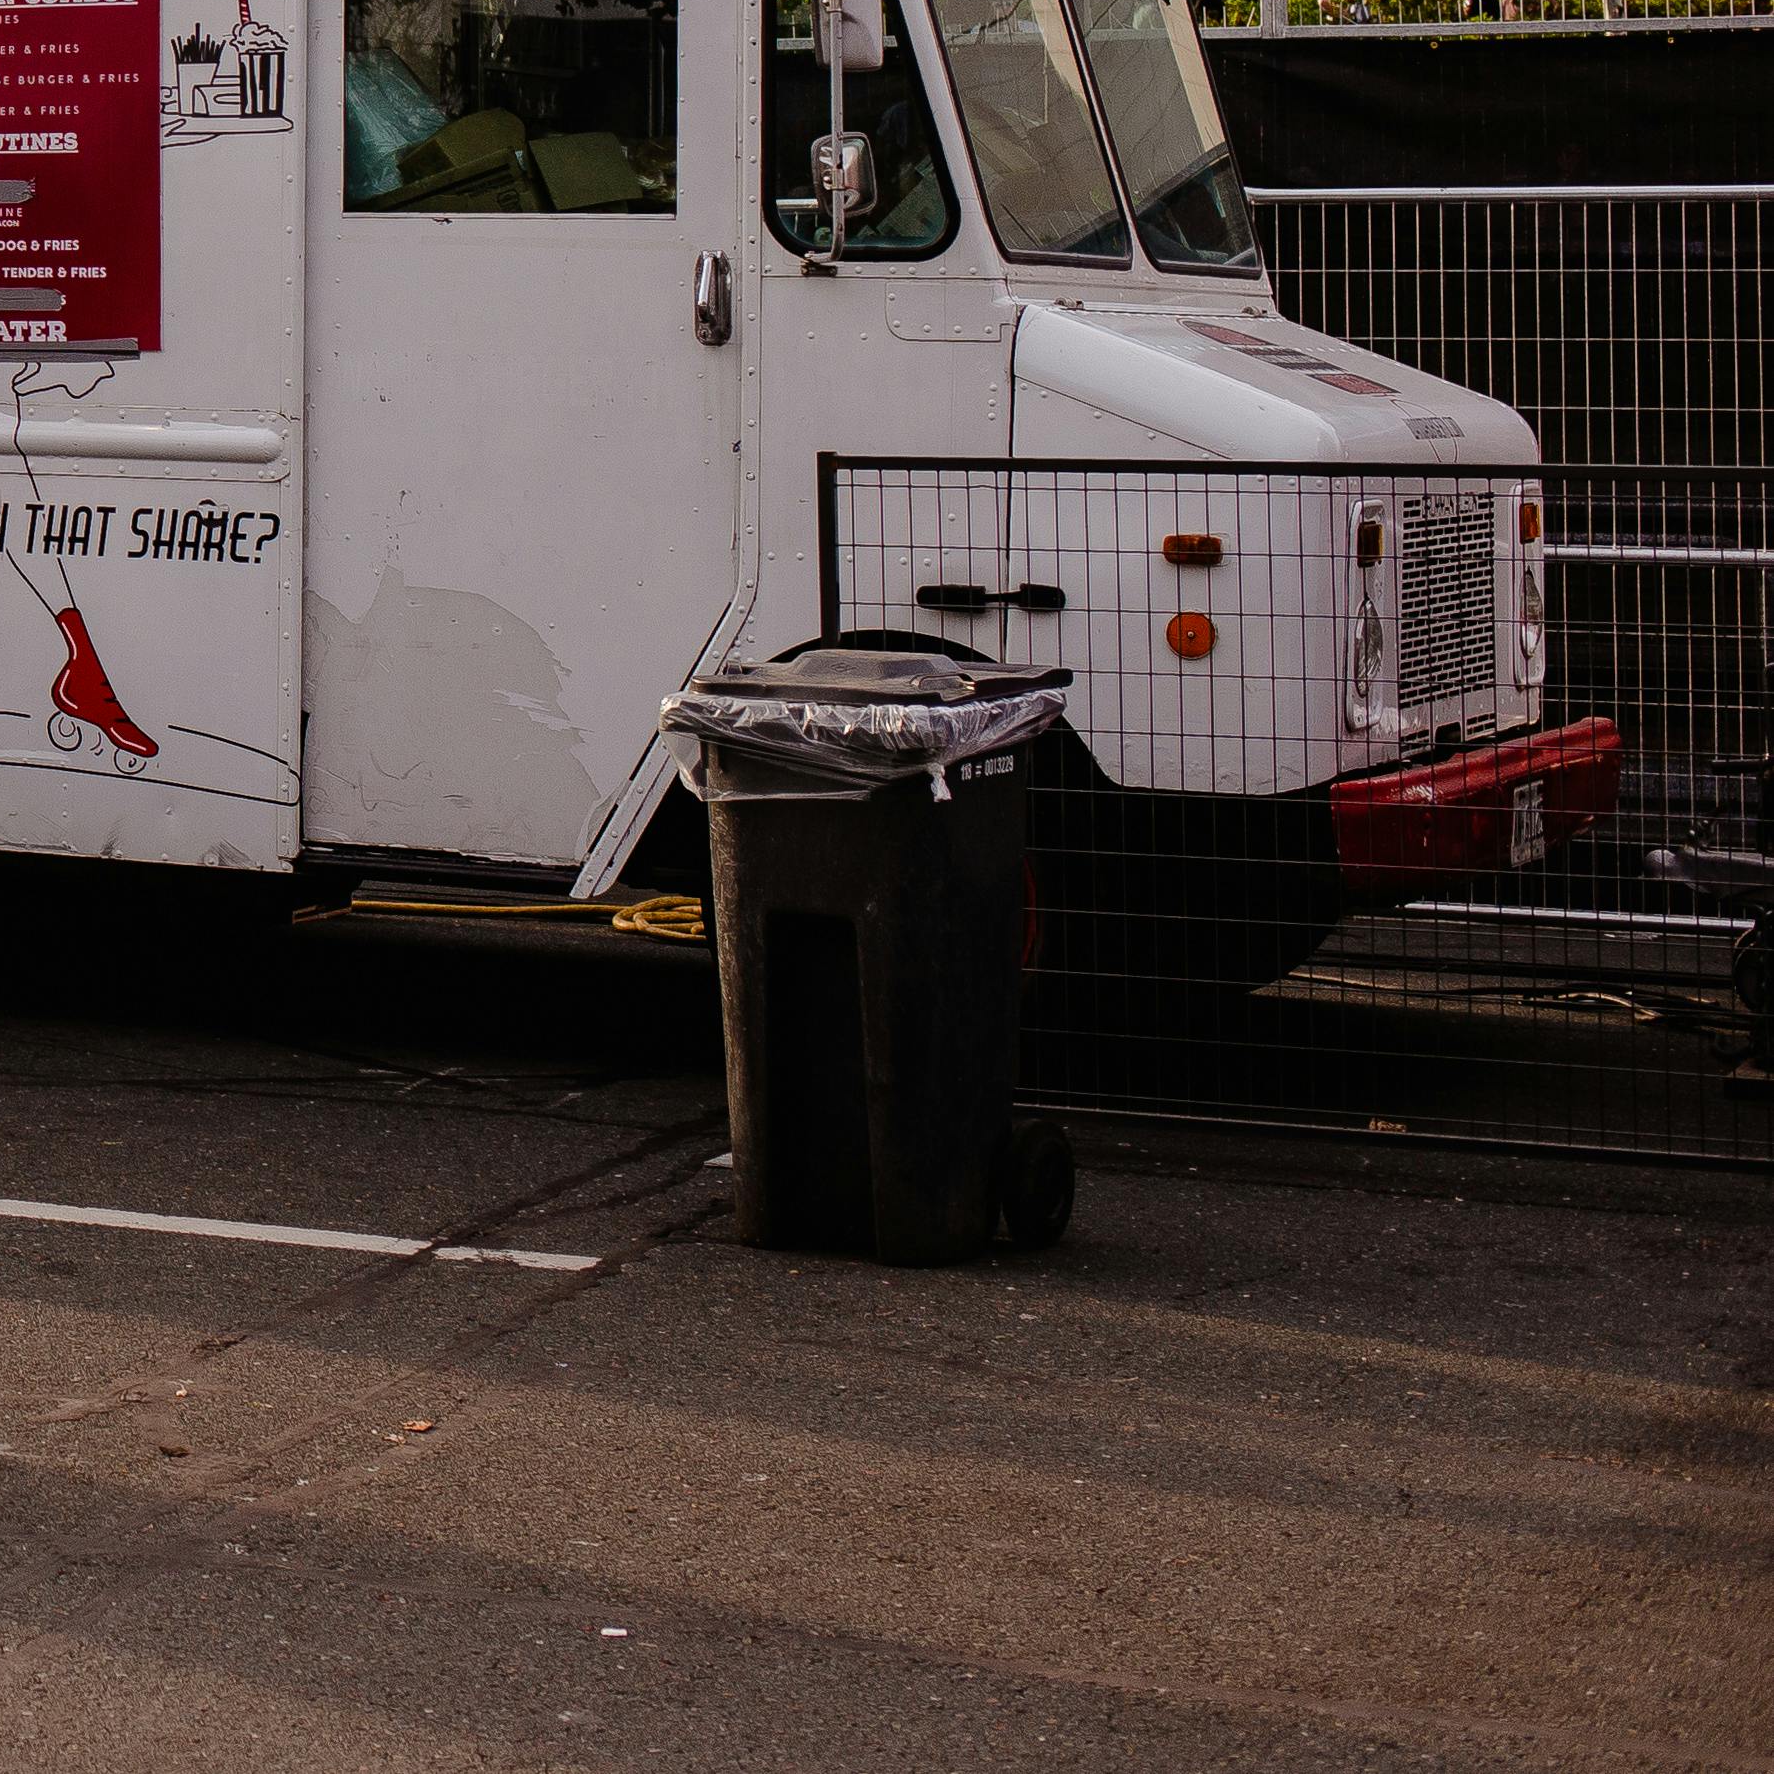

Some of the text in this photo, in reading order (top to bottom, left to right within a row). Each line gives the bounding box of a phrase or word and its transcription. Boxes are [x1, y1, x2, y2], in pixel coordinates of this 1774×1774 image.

[24, 45, 32, 55] &
[41, 44, 80, 54] FRIES
[18, 75, 74, 85] BURGER
[82, 74, 90, 84] &
[99, 73, 140, 83] FRIES
[24, 106, 32, 116] &
[41, 105, 80, 115] FRIES
[31, 240, 40, 251] &
[44, 240, 80, 251] FRIES
[2, 267, 53, 278] TENDER
[57, 267, 67, 278] &
[71, 267, 107, 278] FRIES
[23, 501, 116, 559] THAT
[127, 502, 281, 564] SHAKE?
